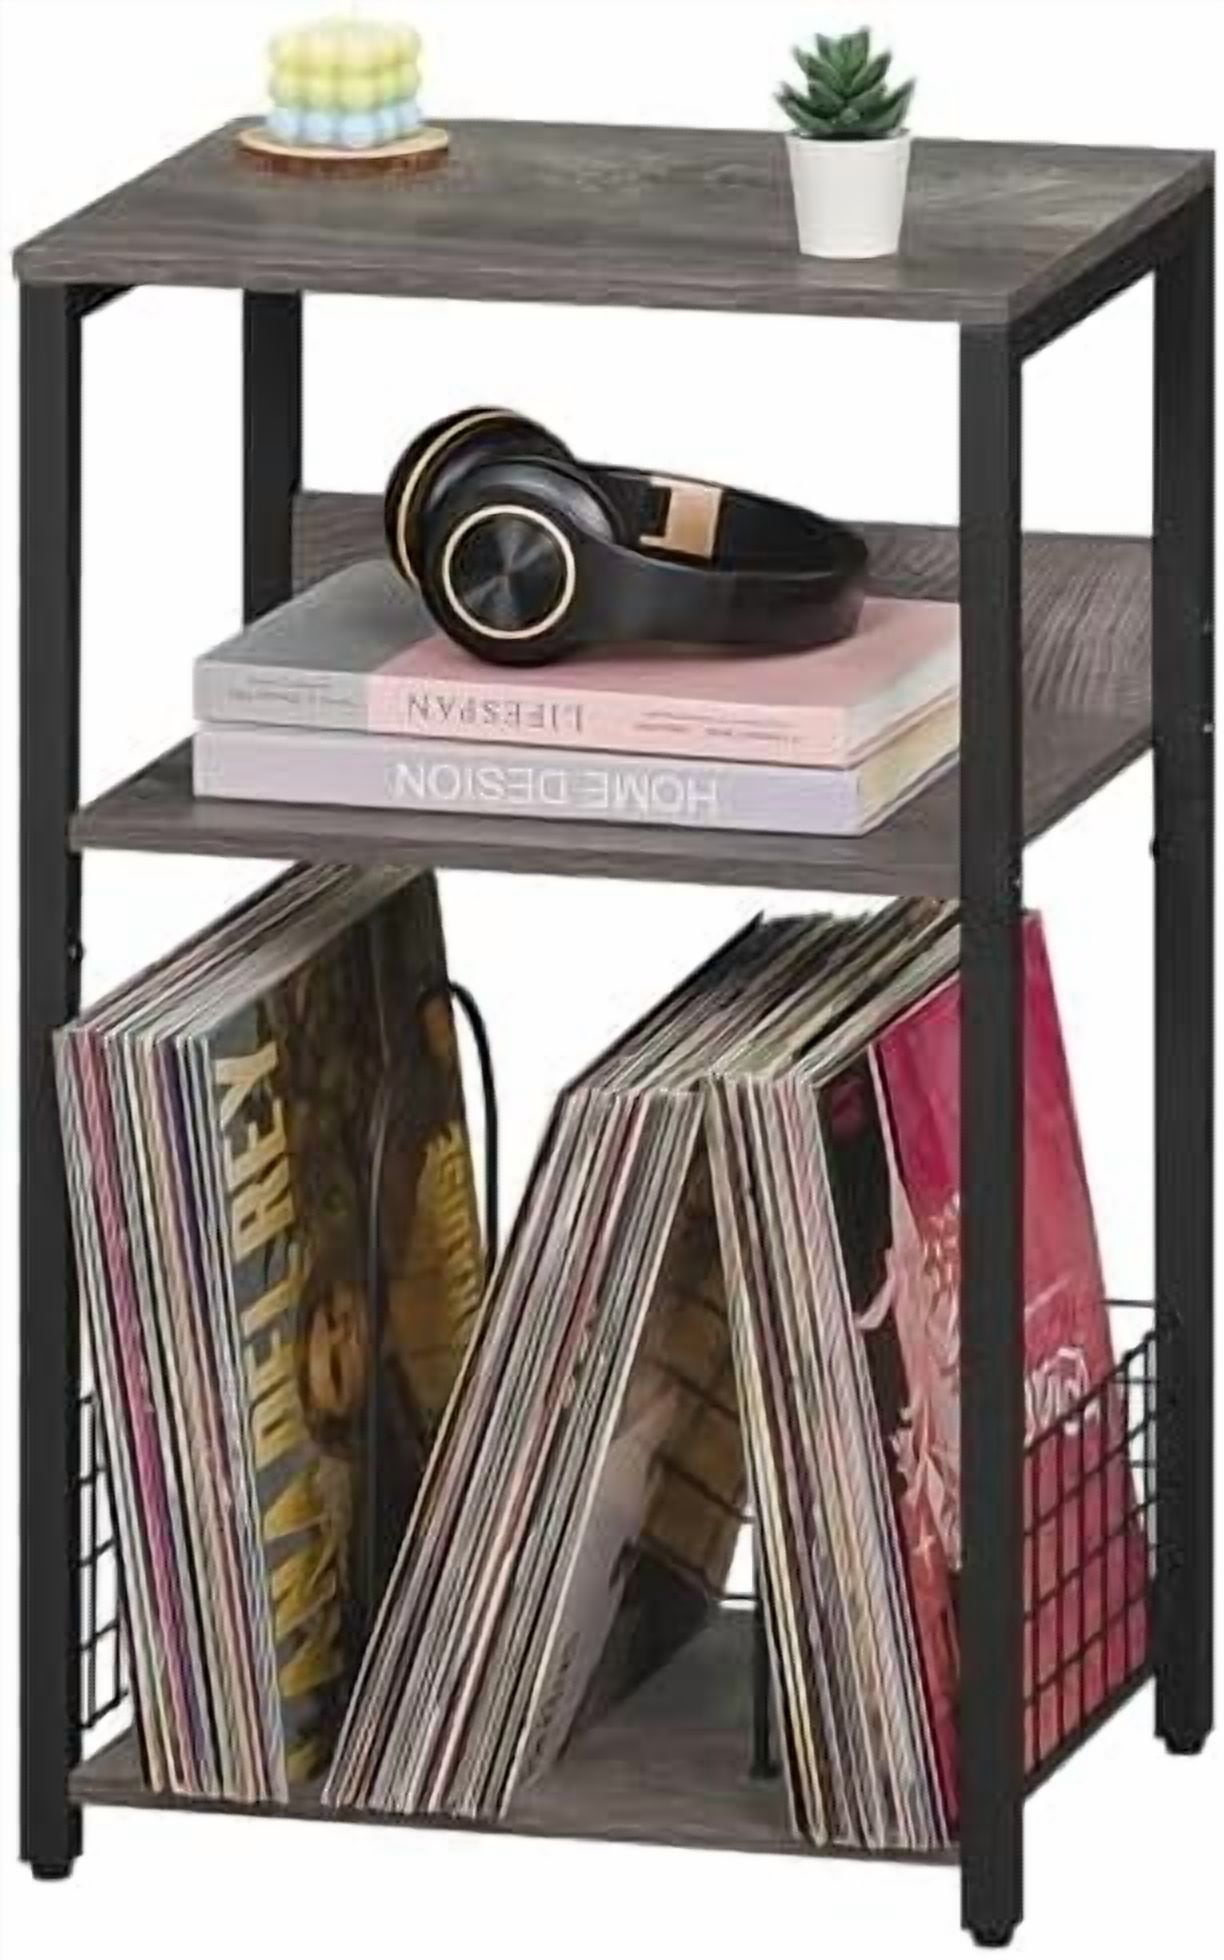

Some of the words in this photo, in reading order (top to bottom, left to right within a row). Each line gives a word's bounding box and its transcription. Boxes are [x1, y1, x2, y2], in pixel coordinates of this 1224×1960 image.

[406, 692, 583, 733] LIFESPAN
[579, 770, 718, 814] HOME
[214, 1040, 296, 1263] REY
[243, 1240, 314, 1472] DEL
